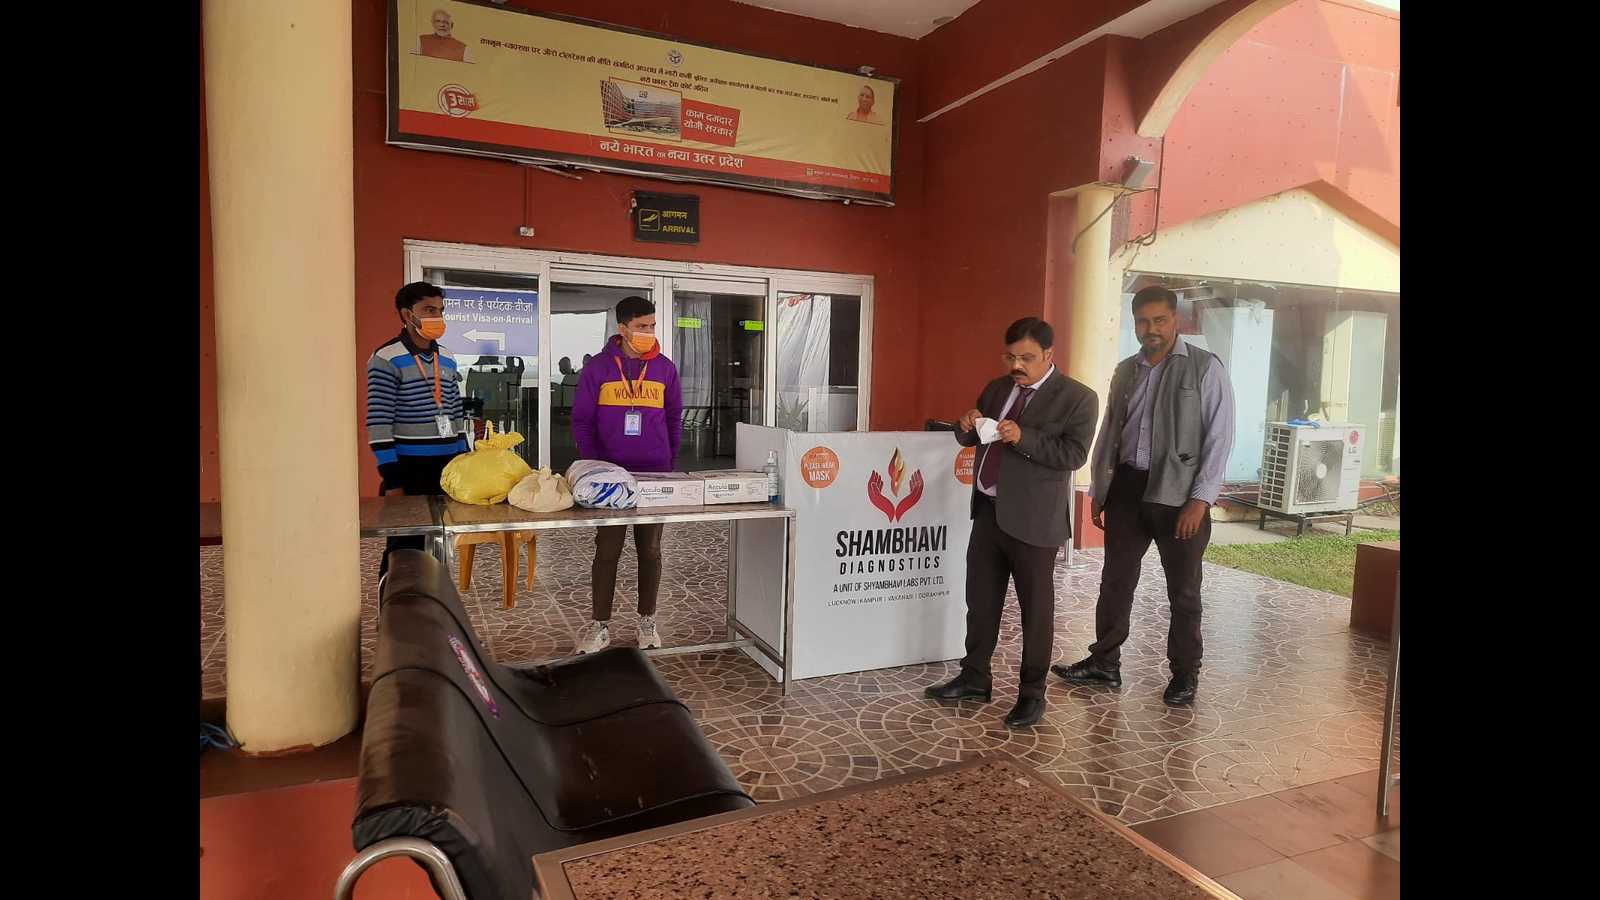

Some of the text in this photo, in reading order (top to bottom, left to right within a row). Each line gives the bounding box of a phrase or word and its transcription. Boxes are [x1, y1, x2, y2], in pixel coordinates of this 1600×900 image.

[531, 46, 541, 55] पर
[686, 108, 734, 127] काम दमदार
[683, 118, 734, 137] योगी सरकार
[600, 140, 620, 153] नये
[623, 143, 654, 158] भारत
[667, 149, 690, 162] नया
[719, 156, 744, 169] प्रदेश
[661, 210, 688, 219] आगमन
[662, 225, 696, 234] ARRIVAL
[463, 299, 475, 309] पर
[472, 312, 533, 325] Visa-on-Arrival
[809, 470, 831, 481] MASK
[835, 525, 948, 558] SHAMBHAVI
[839, 555, 940, 575] DIAGNOSTICS
[833, 584, 838, 593] A
[839, 582, 853, 592] UNIT
[854, 582, 862, 591] OF
[863, 578, 903, 591] SHYAMBHAVI
[904, 577, 919, 587] LABS
[828, 598, 856, 607] LUCKNOW
[860, 596, 883, 604] KANPUR
